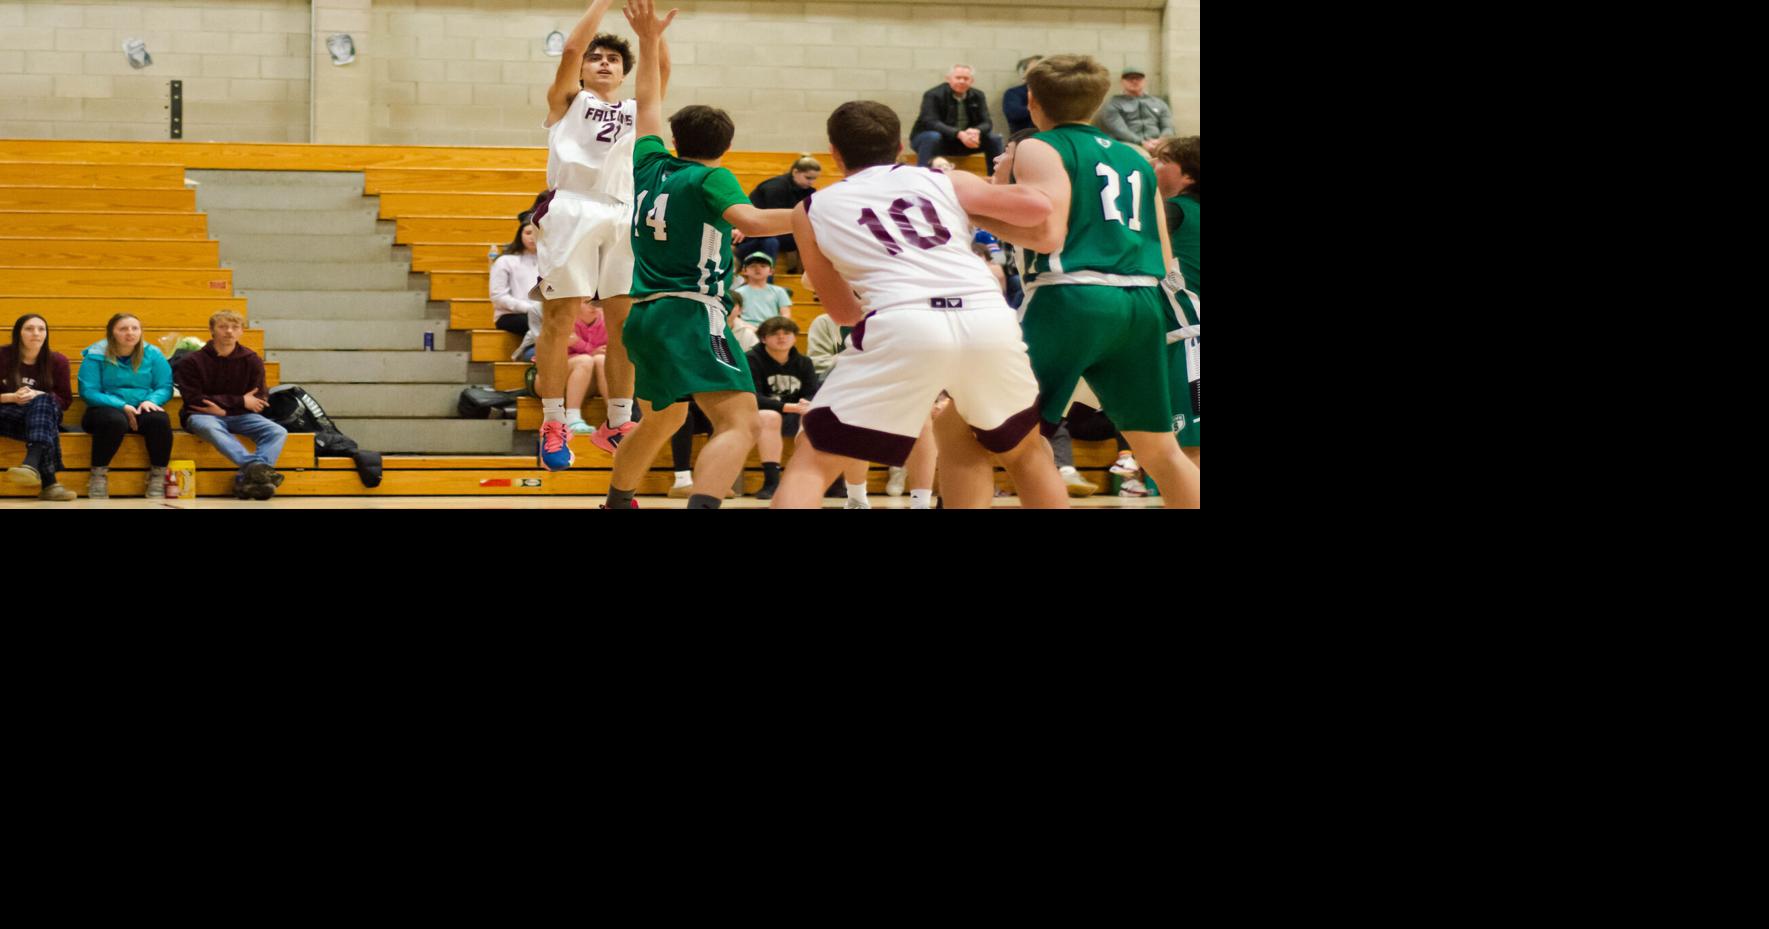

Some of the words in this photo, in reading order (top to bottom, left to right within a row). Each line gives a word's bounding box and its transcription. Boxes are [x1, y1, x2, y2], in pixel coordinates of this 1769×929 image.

[634, 189, 669, 241] 14
[857, 196, 952, 256] 10
[1096, 162, 1142, 232] 21
